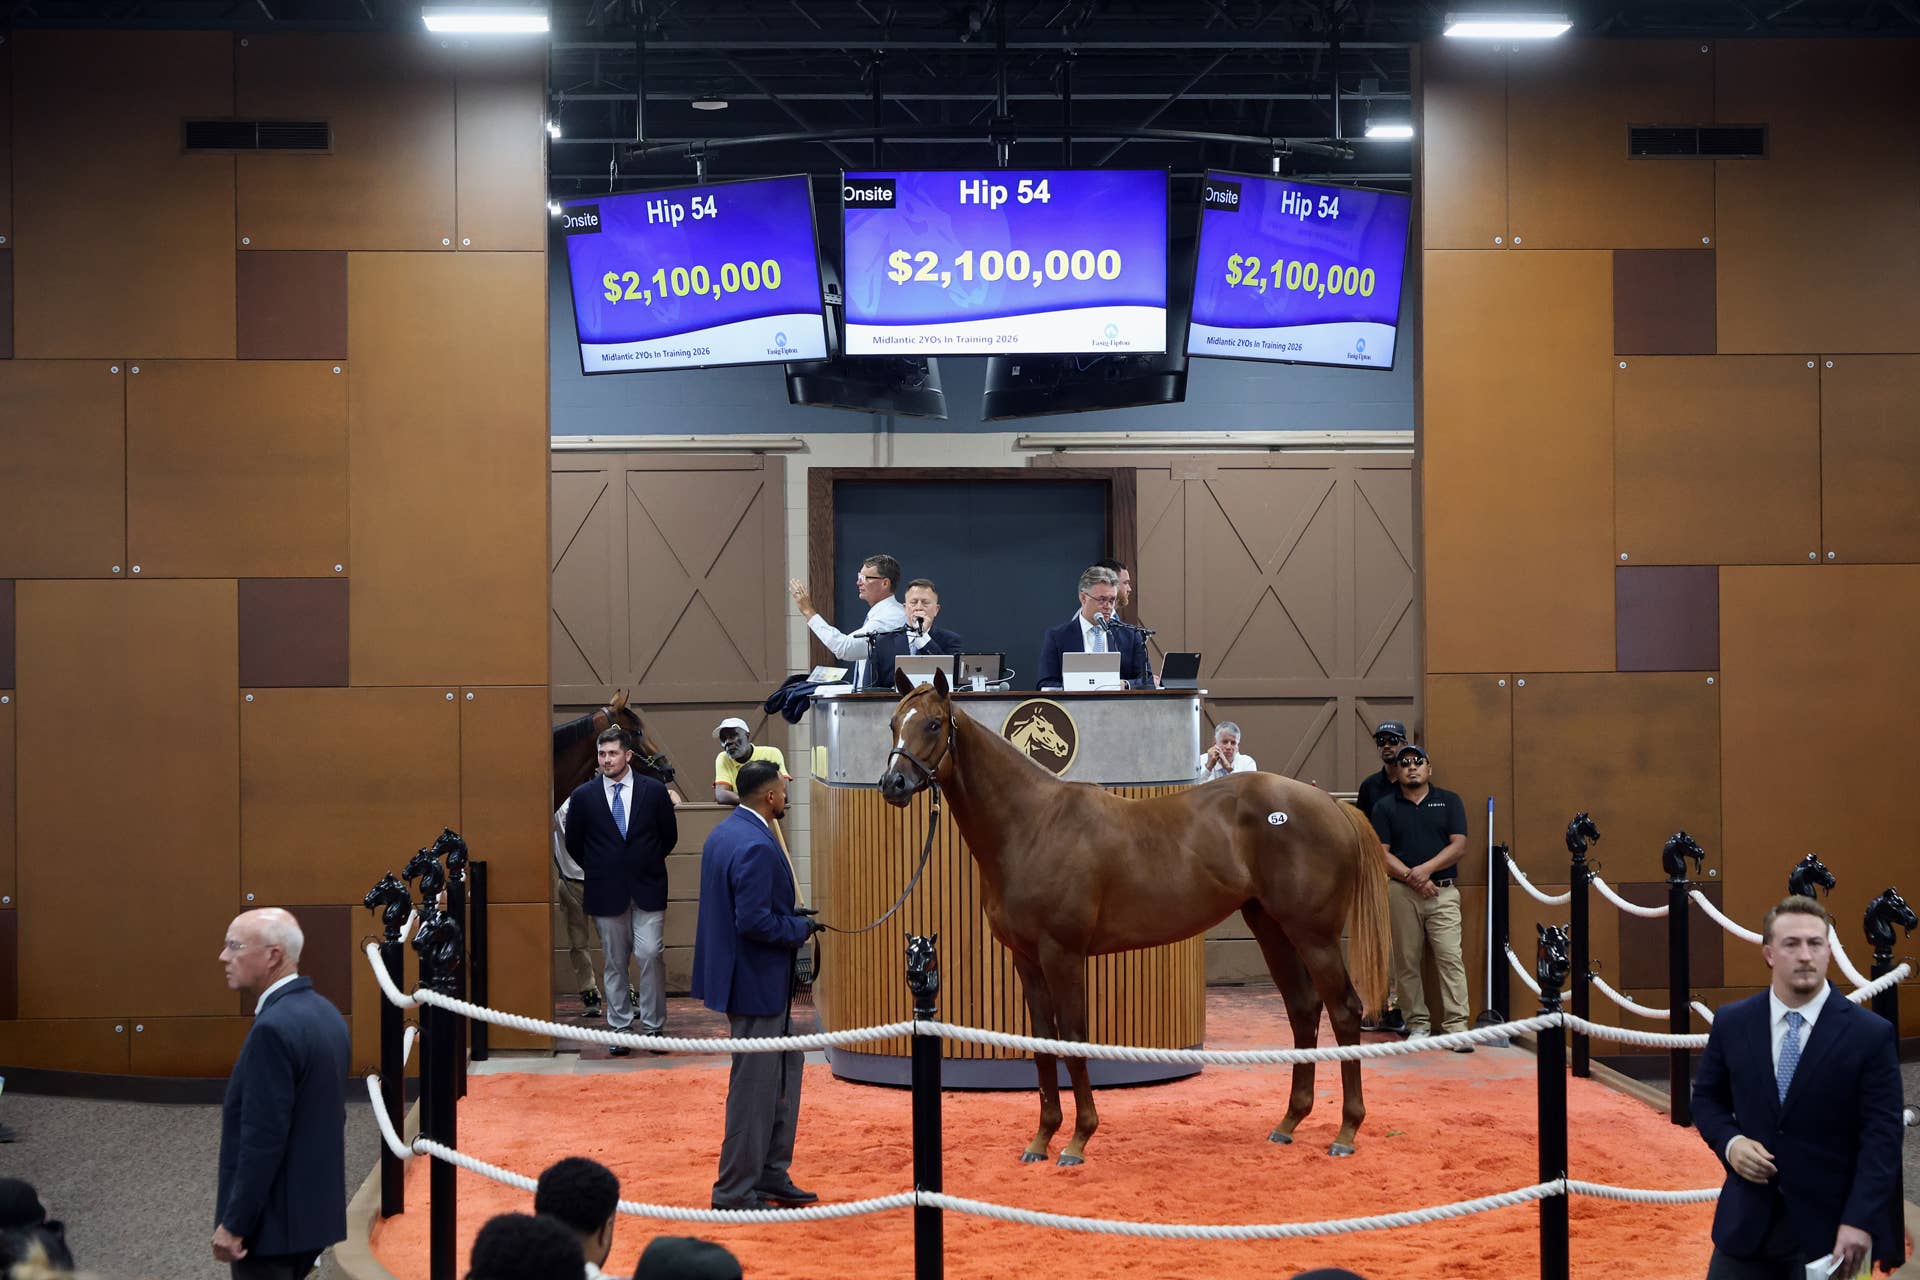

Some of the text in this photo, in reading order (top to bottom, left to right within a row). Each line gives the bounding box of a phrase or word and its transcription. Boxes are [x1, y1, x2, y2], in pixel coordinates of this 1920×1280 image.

[844, 186, 893, 201] Onsite
[959, 179, 1051, 210] Hip 54
[1281, 190, 1339, 221] Hip 54
[646, 195, 718, 228] Hip 54
[602, 259, 782, 306] $2,100,000
[887, 249, 1122, 289] $2,100,000
[1225, 252, 1376, 300] $2,100,000
[601, 347, 711, 361] Midlantic 2YOs In Training 2026
[872, 334, 1019, 345] Midlantic 2YOs In Training 2026
[1206, 336, 1236, 346] Midlantic
[1237, 338, 1253, 348] 2YOs
[1254, 340, 1260, 348] In
[1262, 340, 1286, 352] Training
[1271, 814, 1285, 824] 54
